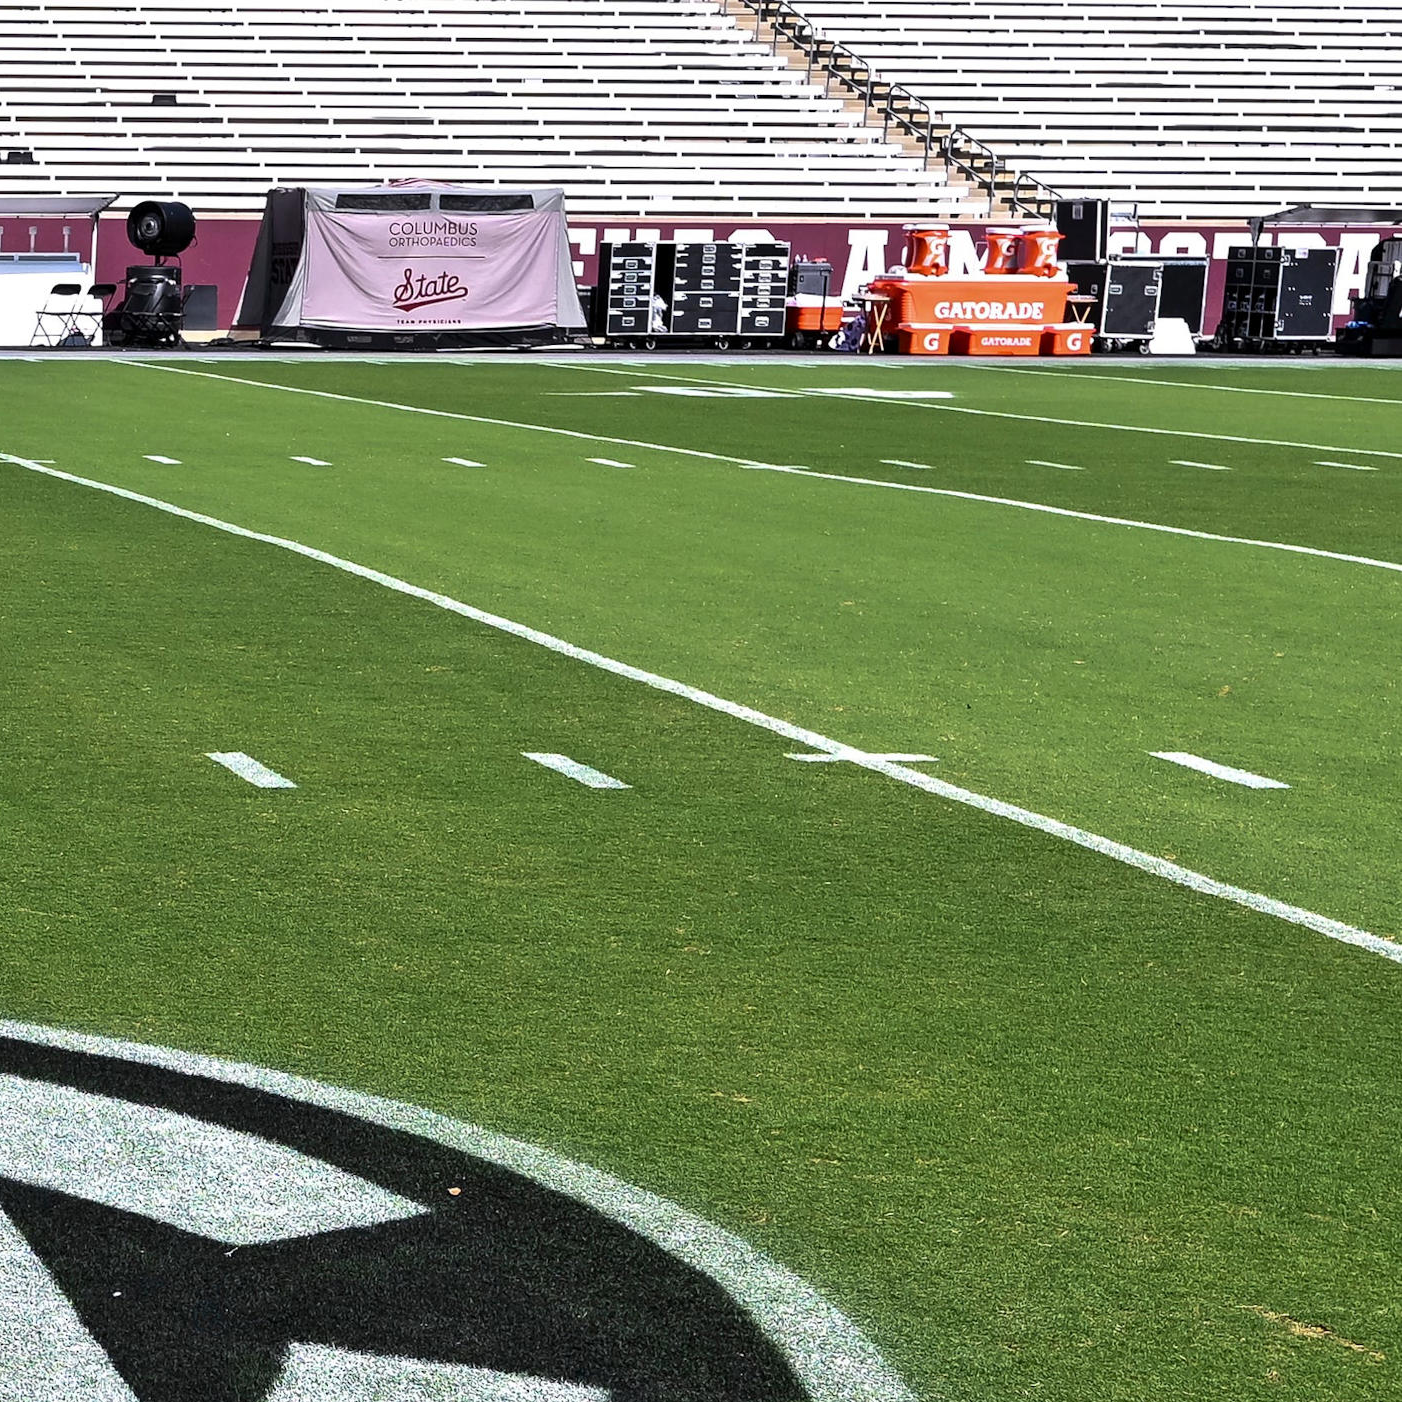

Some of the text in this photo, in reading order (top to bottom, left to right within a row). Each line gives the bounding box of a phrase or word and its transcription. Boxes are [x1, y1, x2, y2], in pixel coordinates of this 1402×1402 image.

[389, 222, 478, 236] COLUMBUS
[389, 236, 477, 248] ORTHOPAEDICS
[392, 268, 469, 312] State
[934, 301, 1044, 320] GATORADE
[924, 333, 940, 351] G
[981, 336, 1033, 347] GATORADE
[1067, 333, 1082, 351] G
